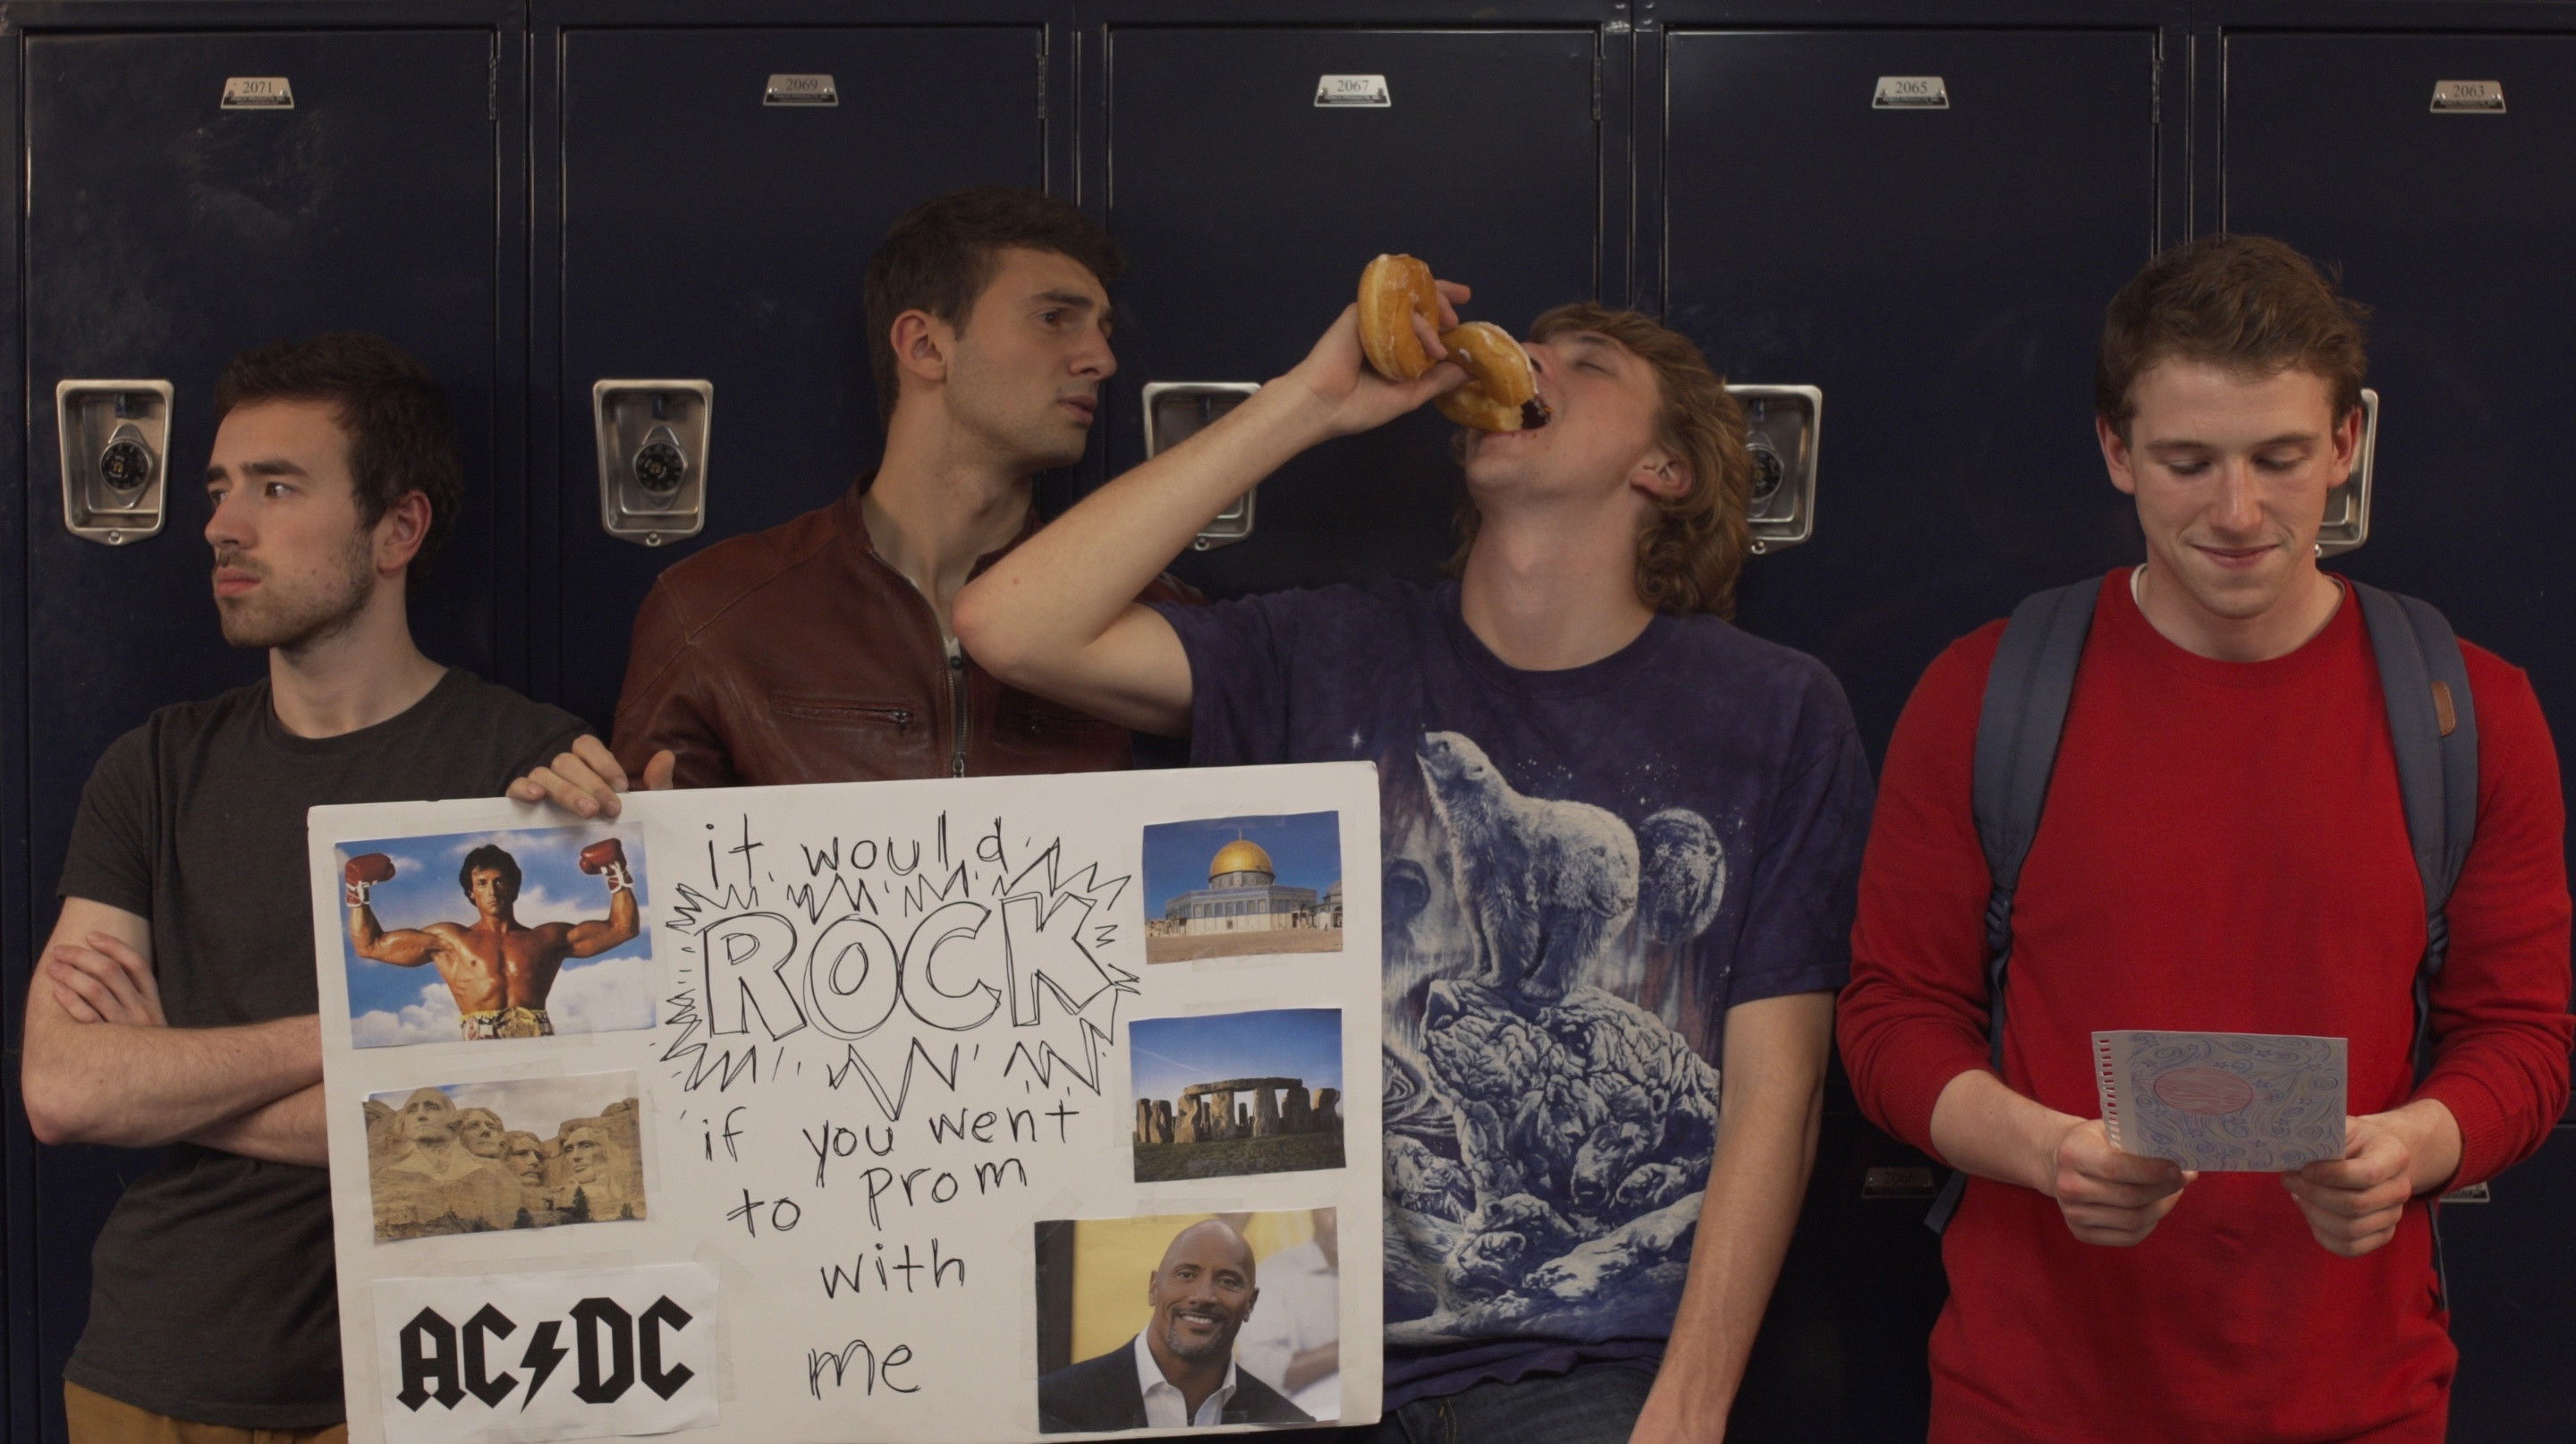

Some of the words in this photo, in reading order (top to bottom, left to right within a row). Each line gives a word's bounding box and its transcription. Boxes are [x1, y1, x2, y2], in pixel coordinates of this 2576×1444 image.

[242, 81, 272, 94] 2071
[786, 78, 818, 91] 2069
[1336, 79, 1369, 92] 2067
[1895, 81, 1928, 94] 2065
[2453, 84, 2485, 98] 2063
[706, 813, 765, 889] it
[801, 810, 1009, 876] would
[699, 891, 1113, 1041] ROCK
[702, 1106, 747, 1162] if
[803, 1119, 894, 1188] you
[928, 1100, 1080, 1144] went
[727, 1188, 801, 1237] to
[821, 1238, 965, 1299] with
[808, 1339, 921, 1401] me
